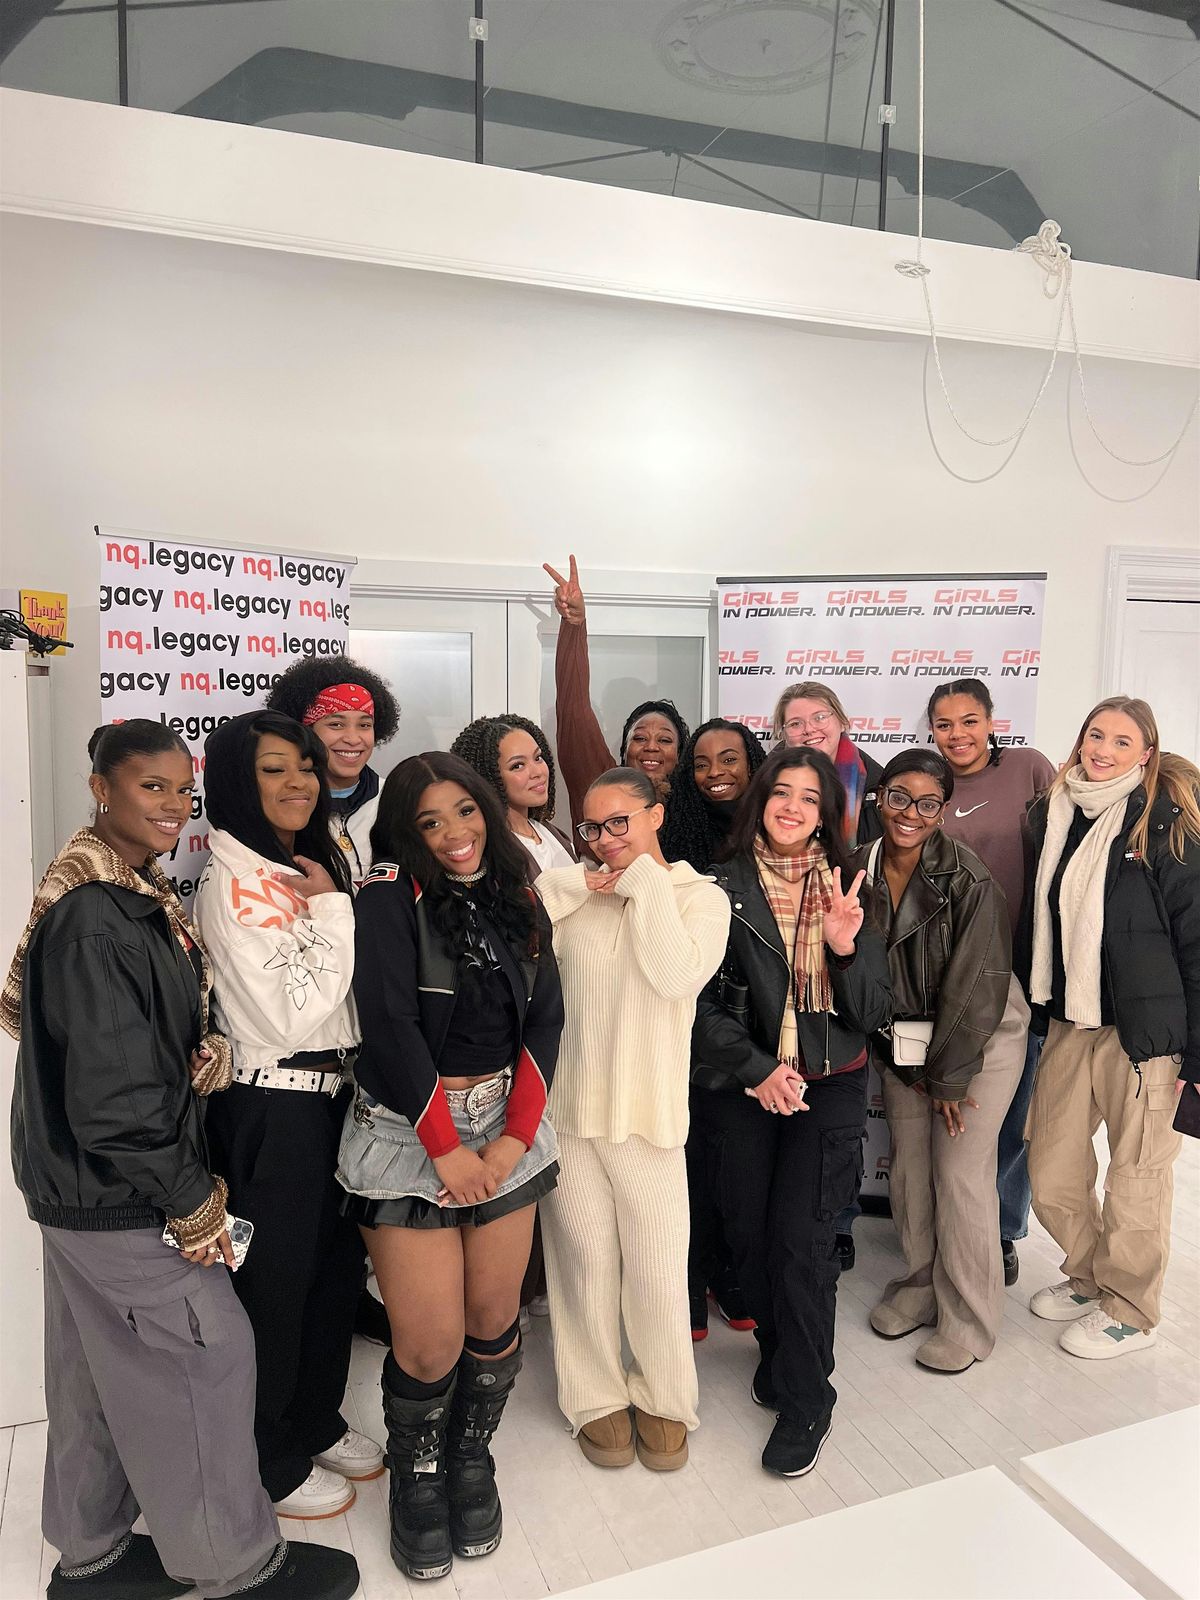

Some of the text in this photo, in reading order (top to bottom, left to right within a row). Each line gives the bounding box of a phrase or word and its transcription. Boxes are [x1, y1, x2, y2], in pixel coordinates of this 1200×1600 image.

[106, 542, 346, 588] nq.legacy nq.legacy
[174, 588, 291, 620] nq.legacy
[723, 607, 742, 619] IN
[826, 605, 846, 617] IN
[933, 604, 954, 616] IN
[107, 626, 346, 659] nq.legacy nq.legacy
[785, 664, 805, 676] IN
[890, 664, 910, 676] IN
[1001, 666, 1021, 677] IN
[849, 717, 902, 731] RLS
